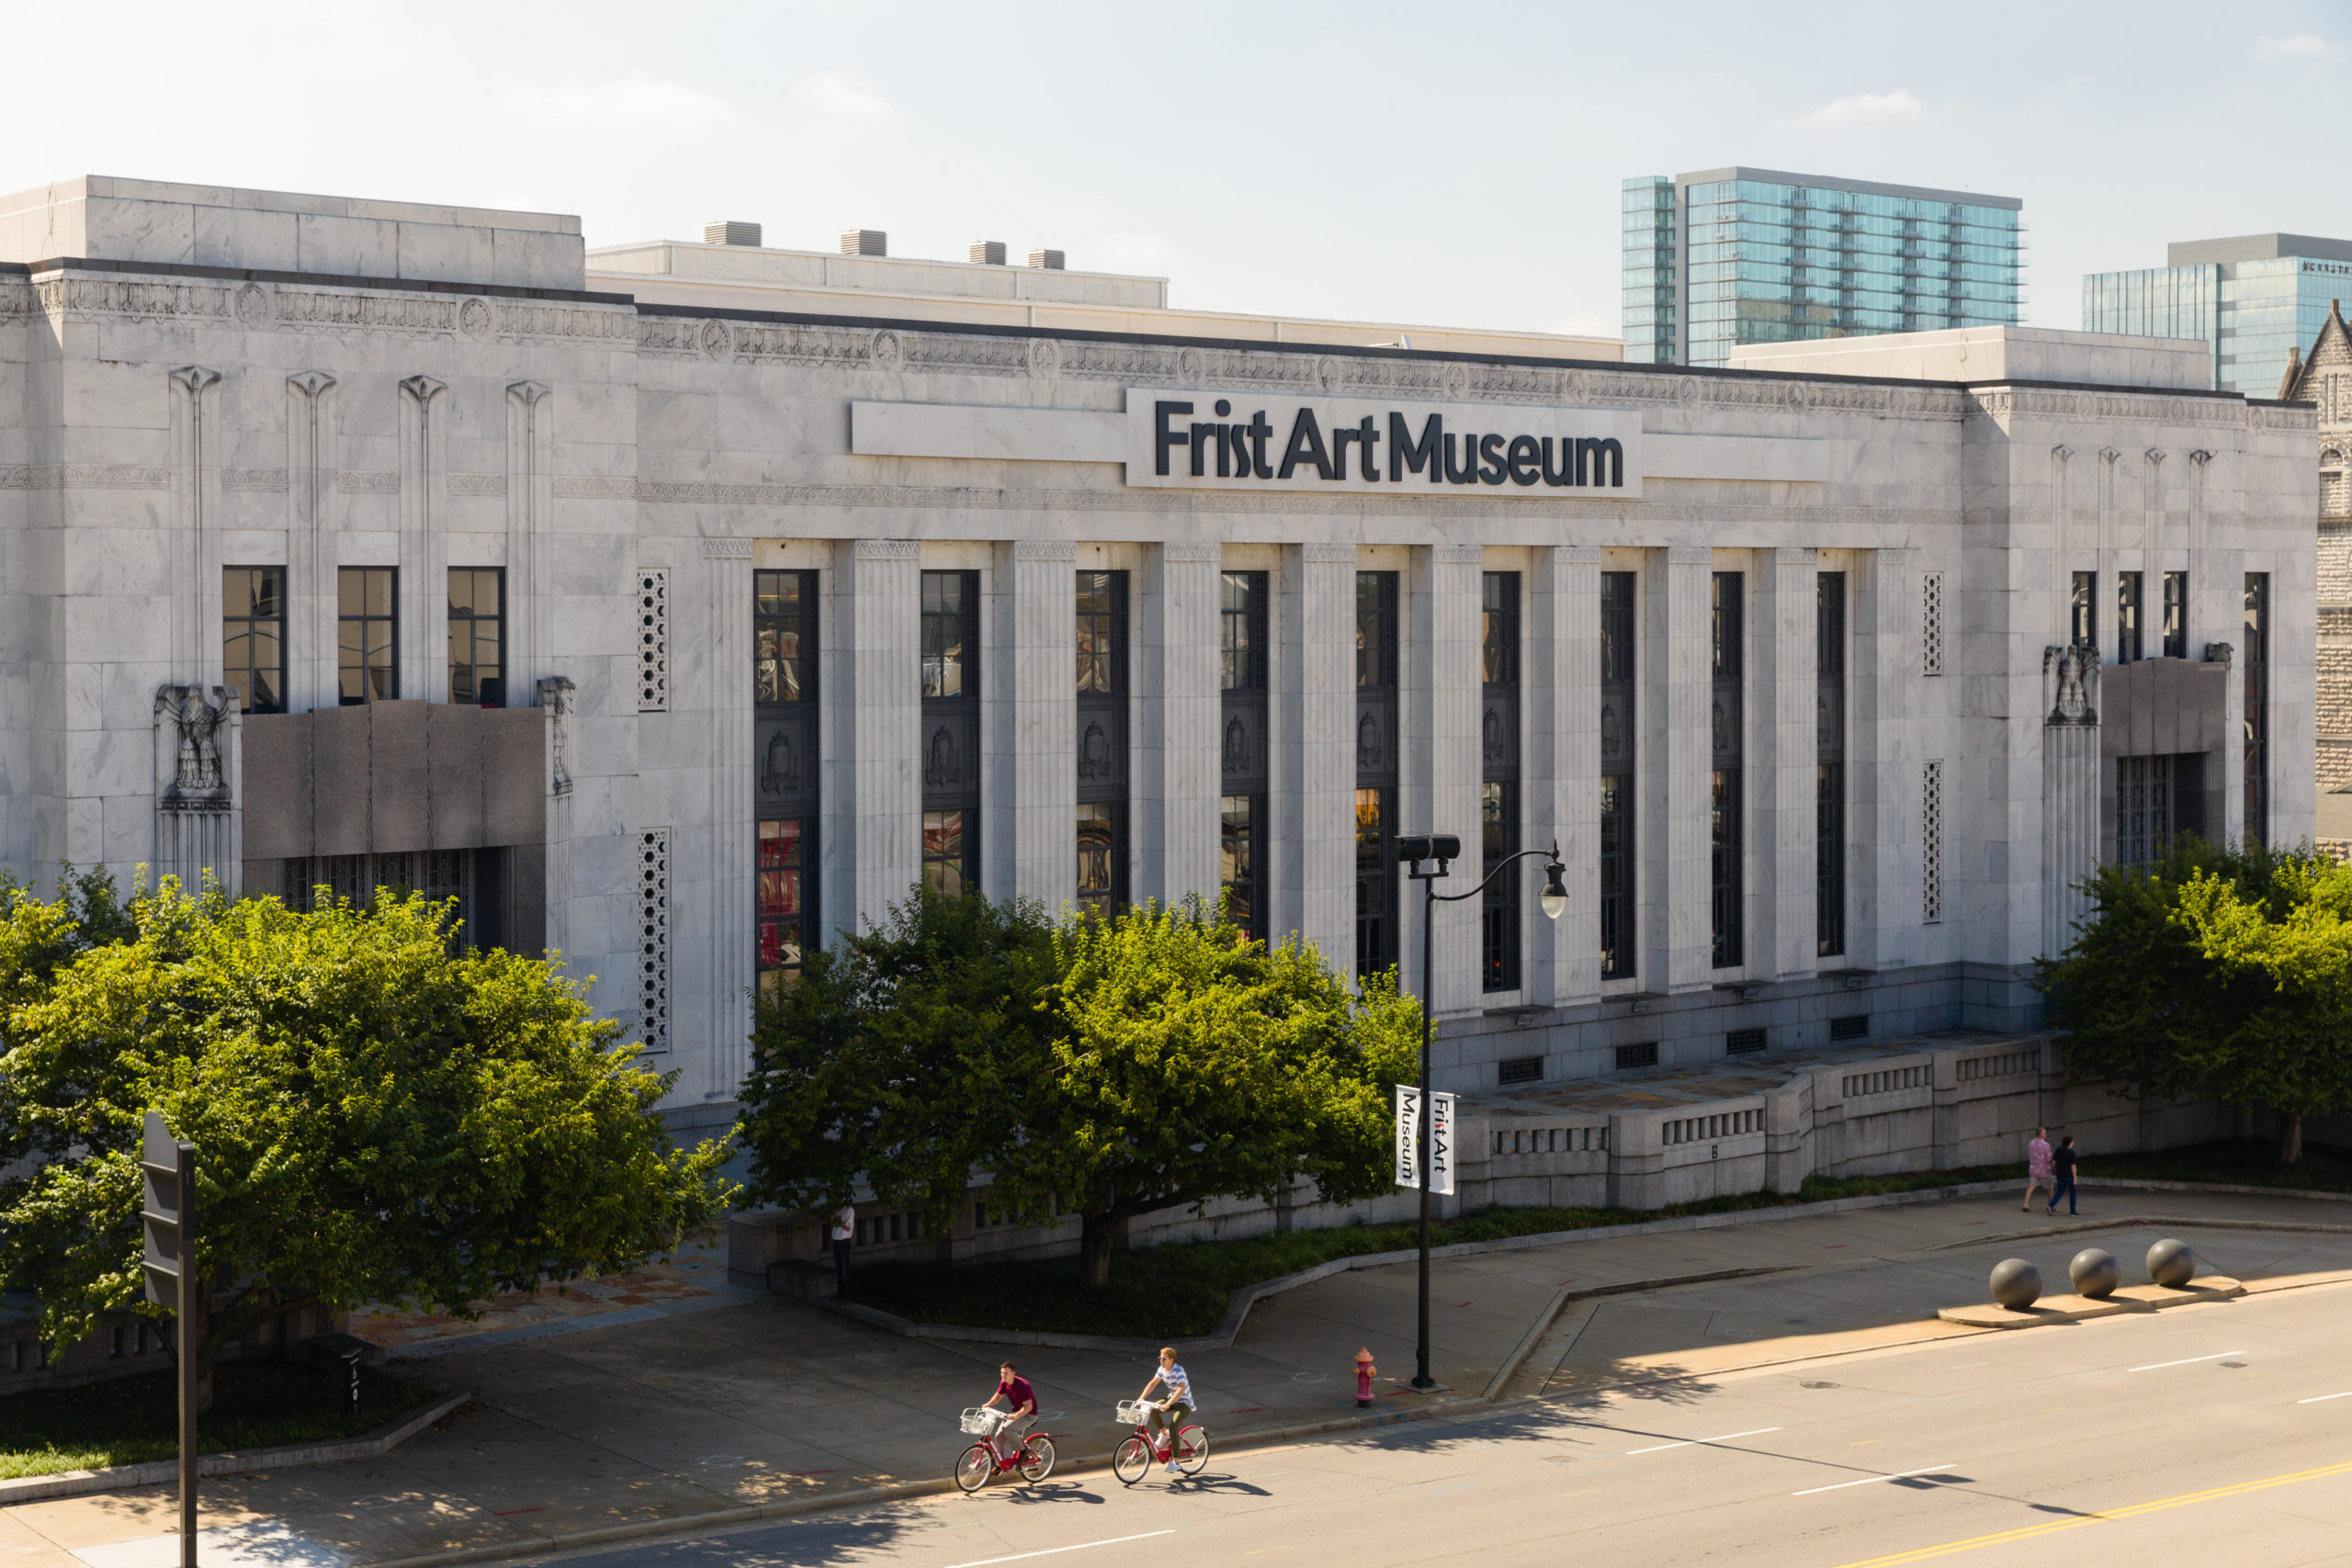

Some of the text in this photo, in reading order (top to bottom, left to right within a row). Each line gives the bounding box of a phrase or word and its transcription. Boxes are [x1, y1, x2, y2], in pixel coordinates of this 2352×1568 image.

[1156, 400, 1623, 488] Frist Art Museum
[1402, 1093, 1417, 1179] Museum
[1434, 1099, 1449, 1174] Frist Art
